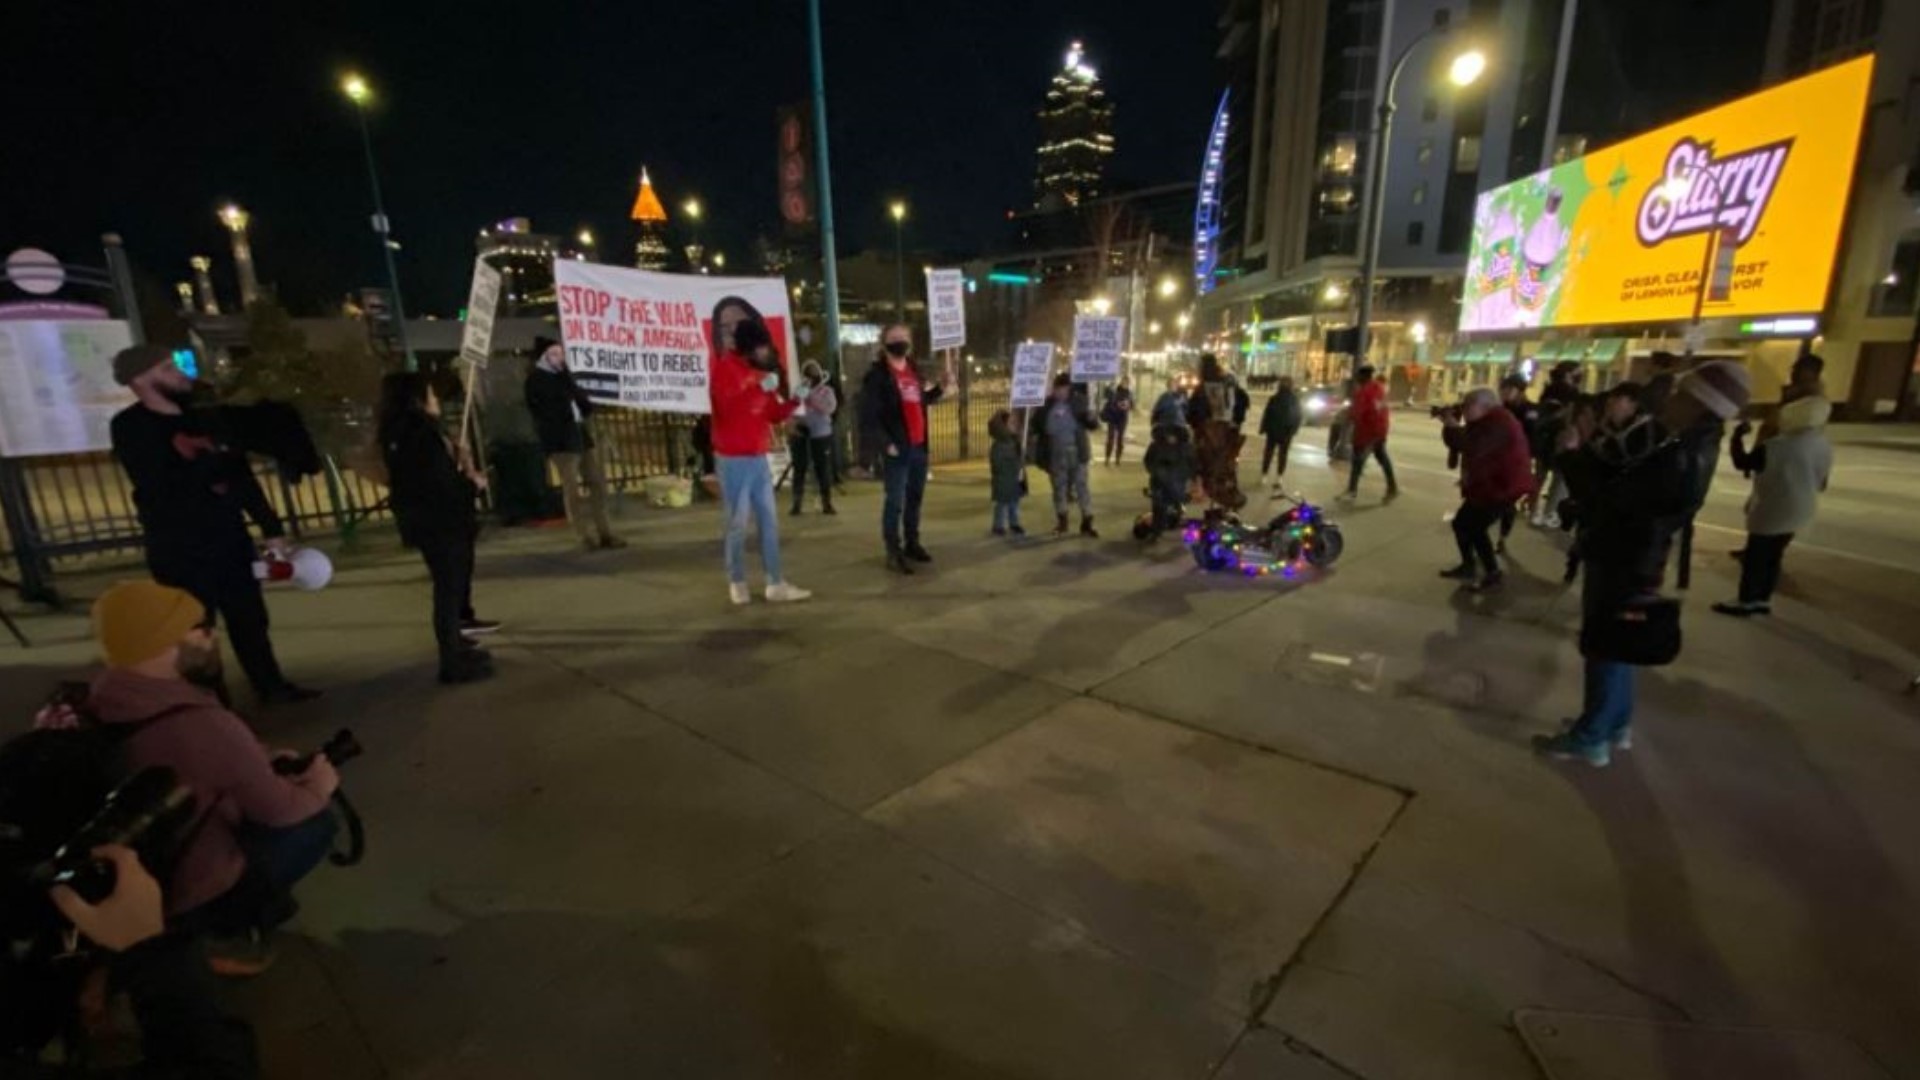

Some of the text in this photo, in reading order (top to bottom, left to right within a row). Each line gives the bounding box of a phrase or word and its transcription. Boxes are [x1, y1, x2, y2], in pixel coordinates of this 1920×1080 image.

[1636, 138, 1793, 247] Starry
[561, 284, 698, 327] STOP THE WAR
[588, 321, 636, 347] BLACK
[597, 349, 637, 370] RIGHT
[642, 352, 659, 371] TO
[662, 353, 705, 373] REBEL
